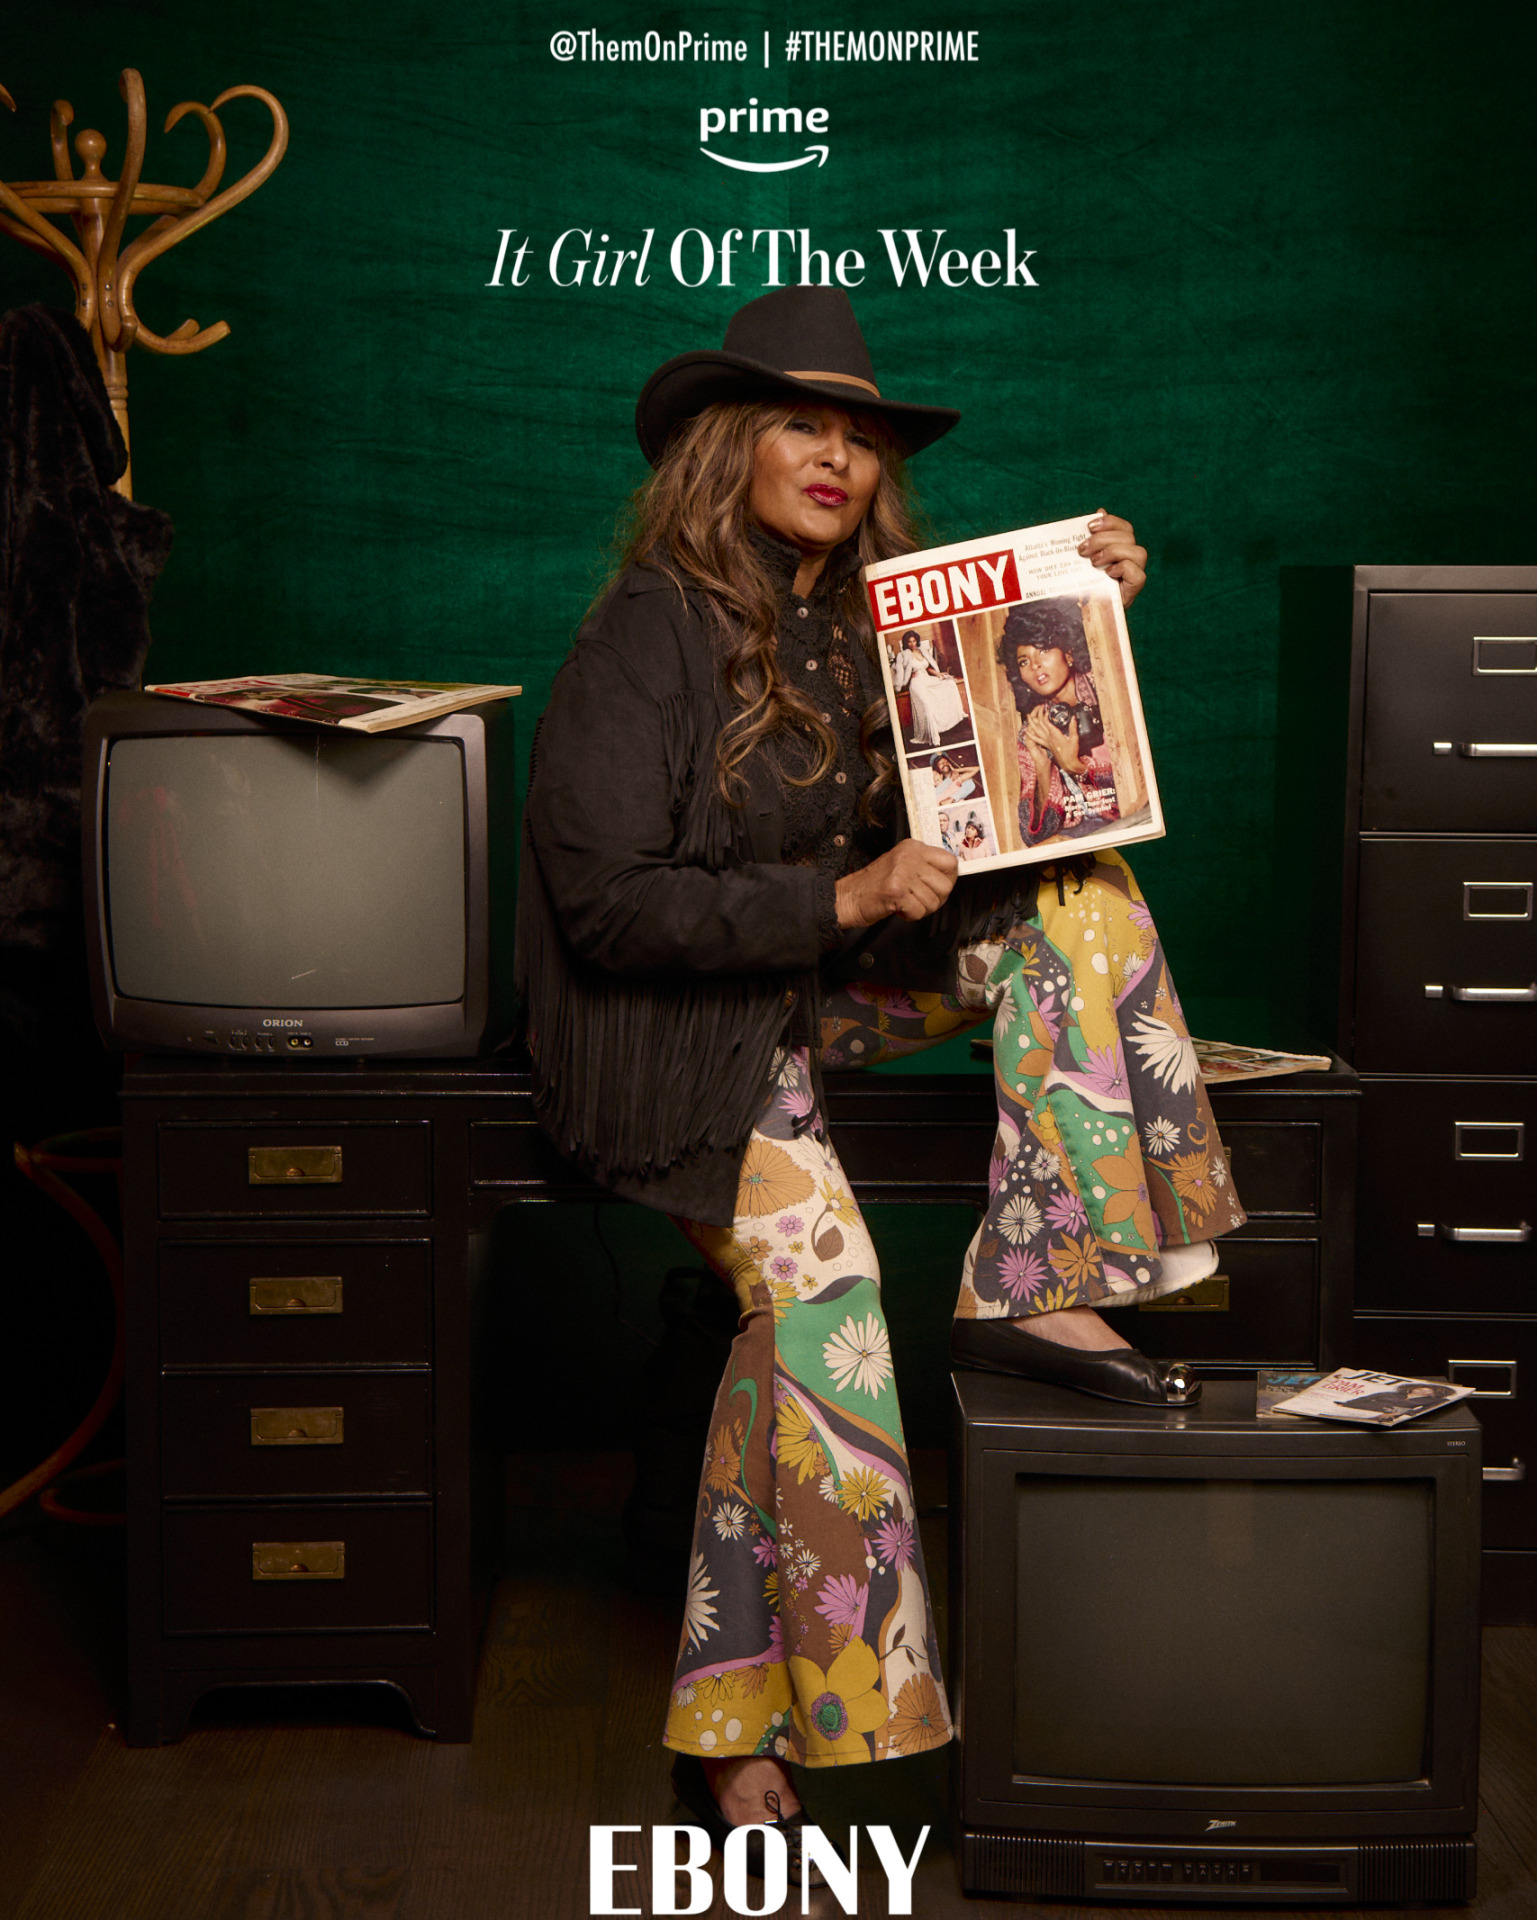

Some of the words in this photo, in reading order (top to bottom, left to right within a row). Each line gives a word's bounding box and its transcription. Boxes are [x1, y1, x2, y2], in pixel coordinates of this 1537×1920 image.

[873, 554, 1009, 627] EBONY
[1063, 793, 1085, 804] PAM
[1086, 788, 1116, 800] GRIER:
[262, 1018, 304, 1028] ORION
[1267, 1375, 1321, 1386] JET
[1343, 1372, 1414, 1386] JET
